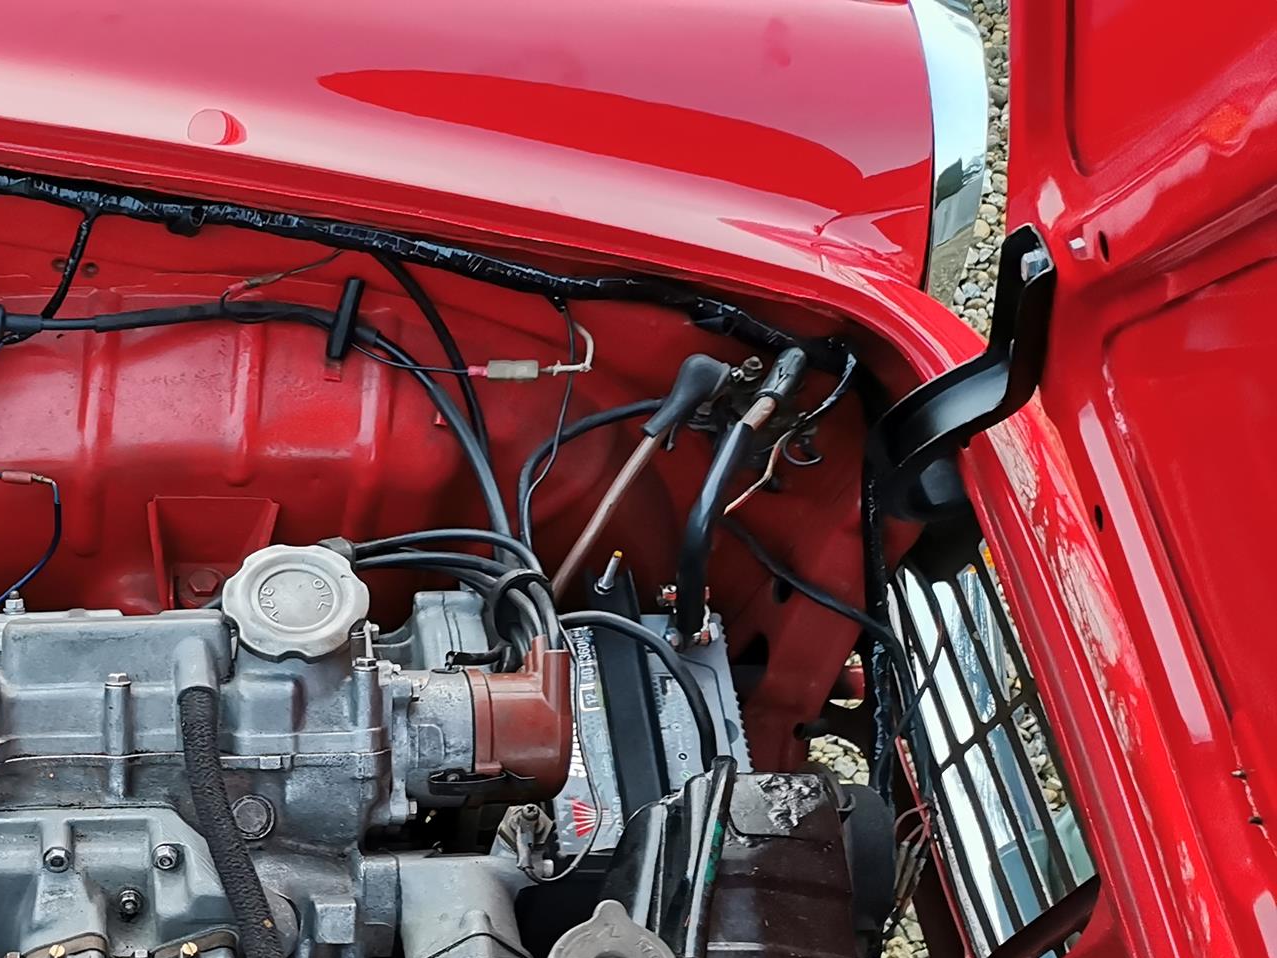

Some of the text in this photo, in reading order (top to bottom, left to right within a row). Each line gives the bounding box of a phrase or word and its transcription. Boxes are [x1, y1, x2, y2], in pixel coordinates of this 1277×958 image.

[311, 577, 333, 612] OIL
[576, 641, 593, 661] 360
[581, 667, 595, 681] 40
